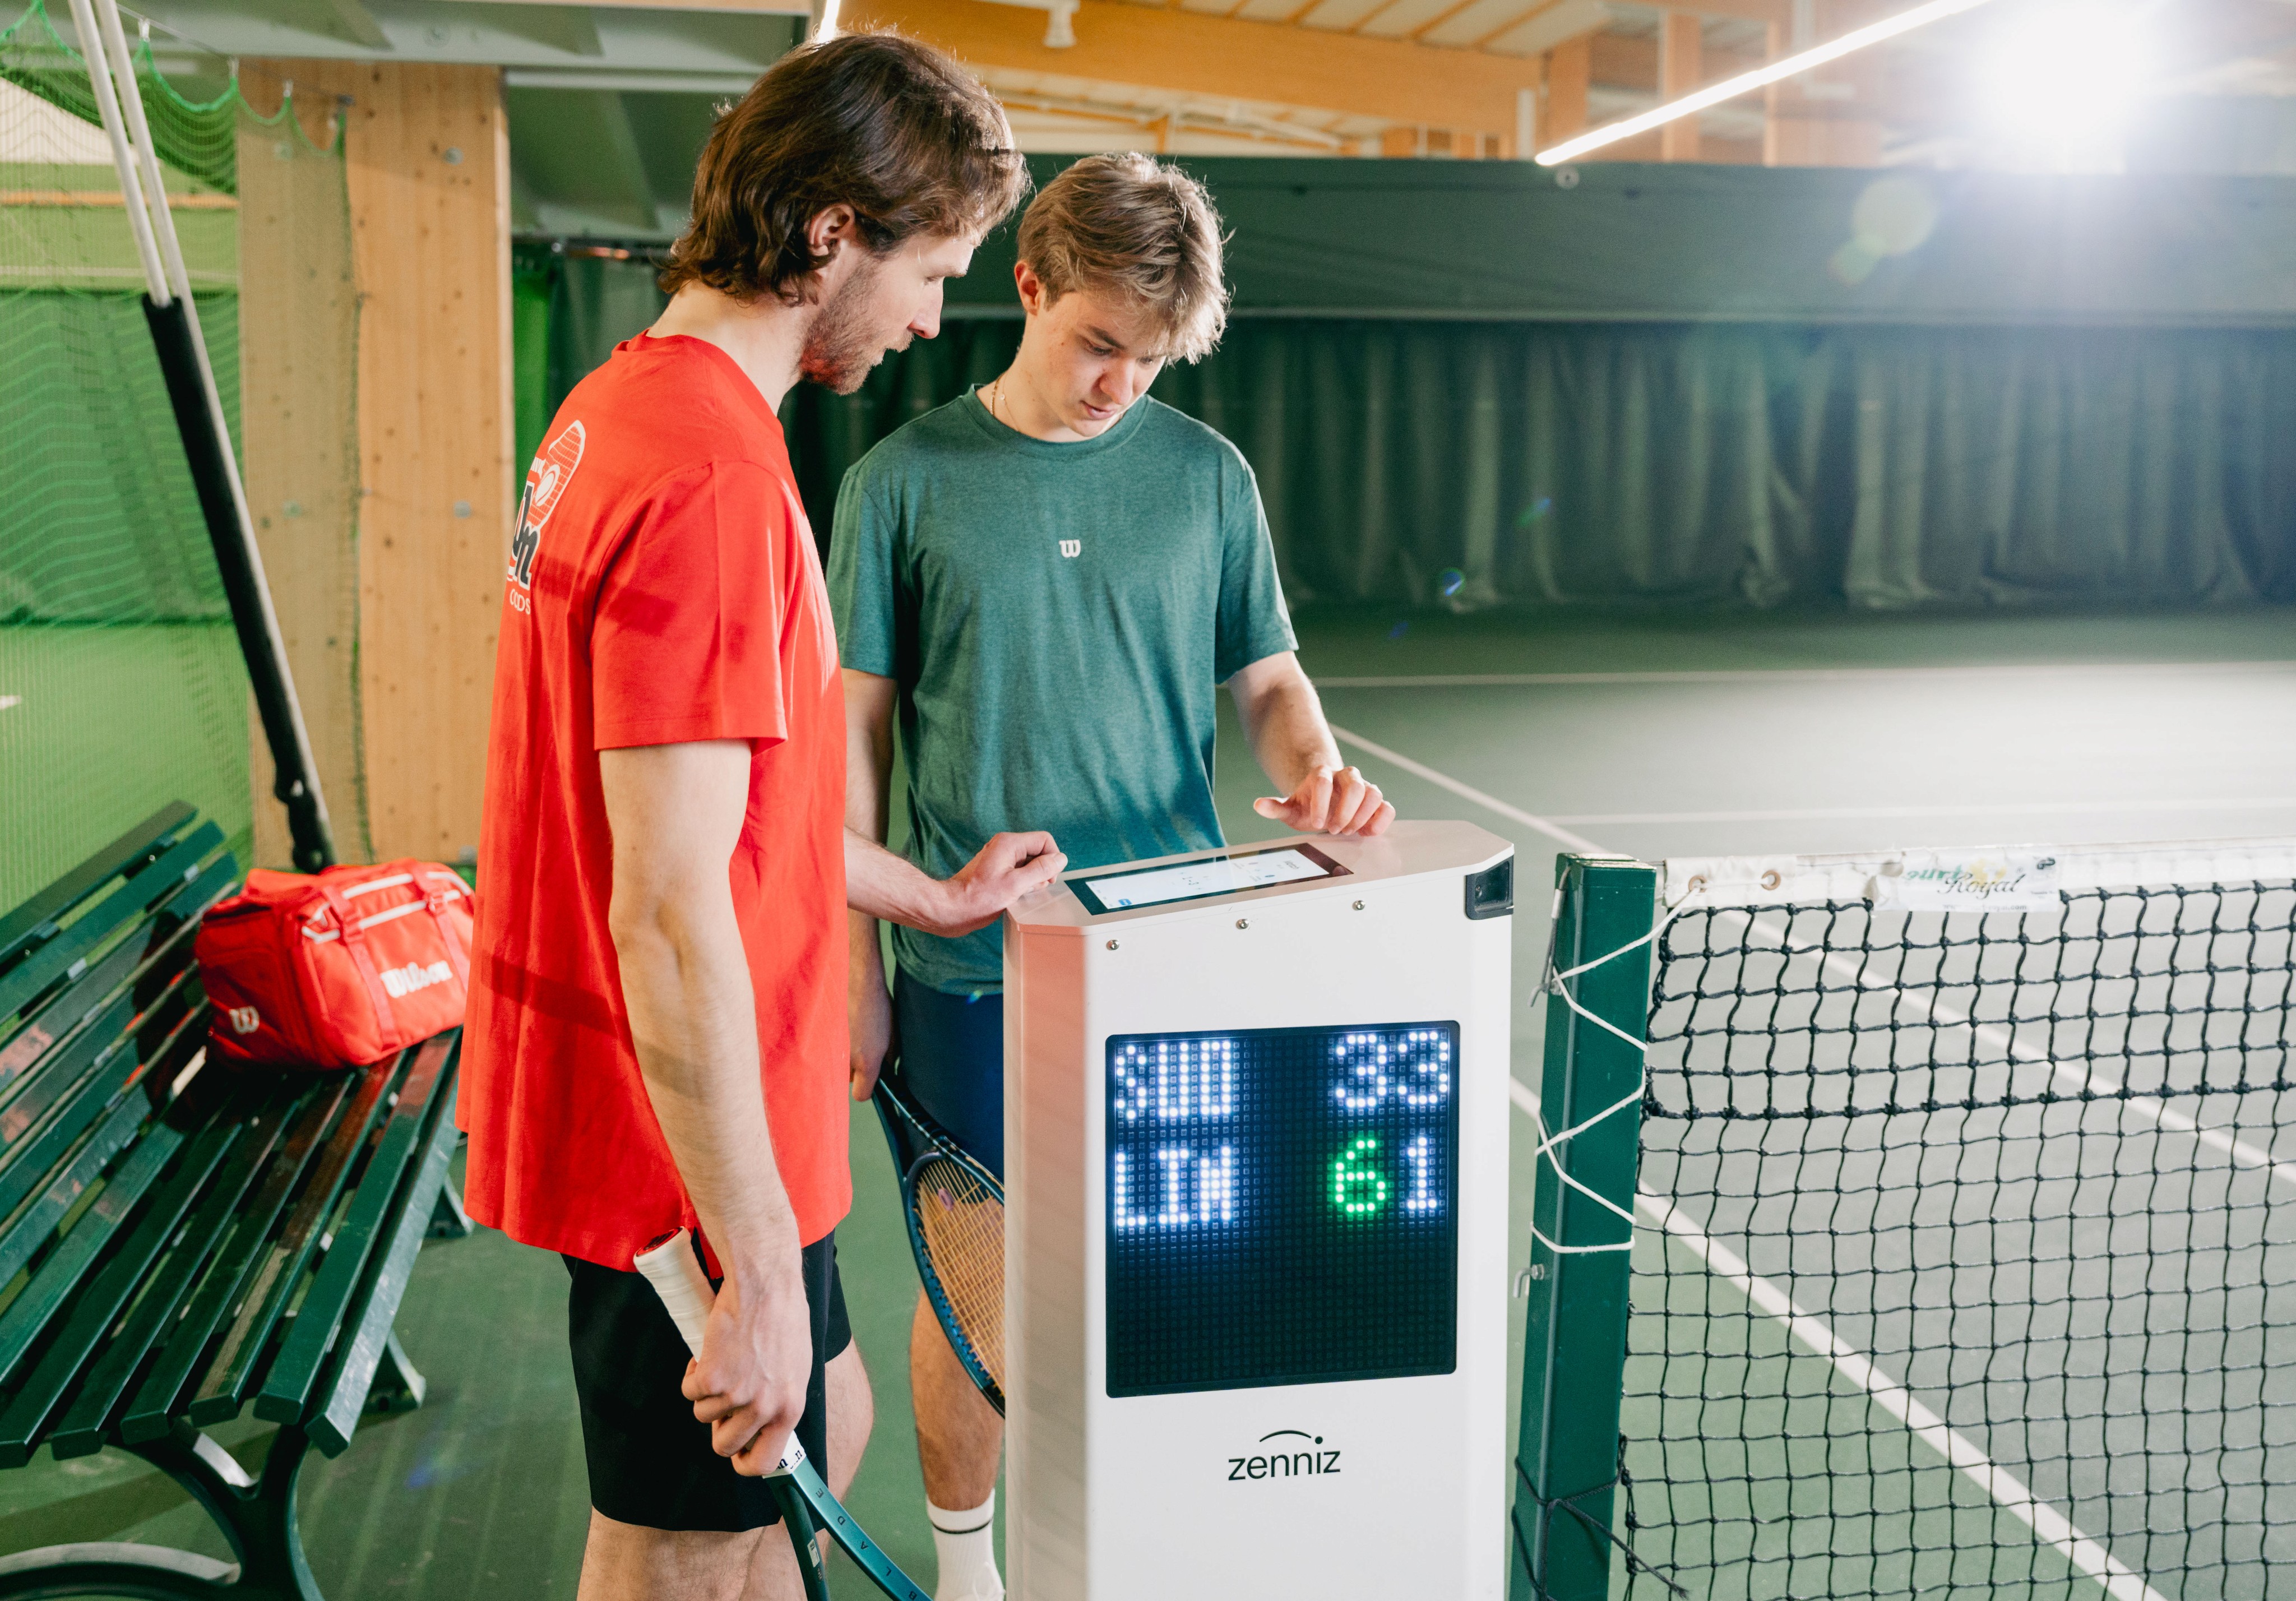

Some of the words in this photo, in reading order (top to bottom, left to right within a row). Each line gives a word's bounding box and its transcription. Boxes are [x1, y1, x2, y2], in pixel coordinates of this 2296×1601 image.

[1058, 539, 1081, 558] W
[1937, 872, 2027, 899] Royal
[380, 961, 453, 998] Wilson
[1228, 1436, 1341, 1480] zenniz
